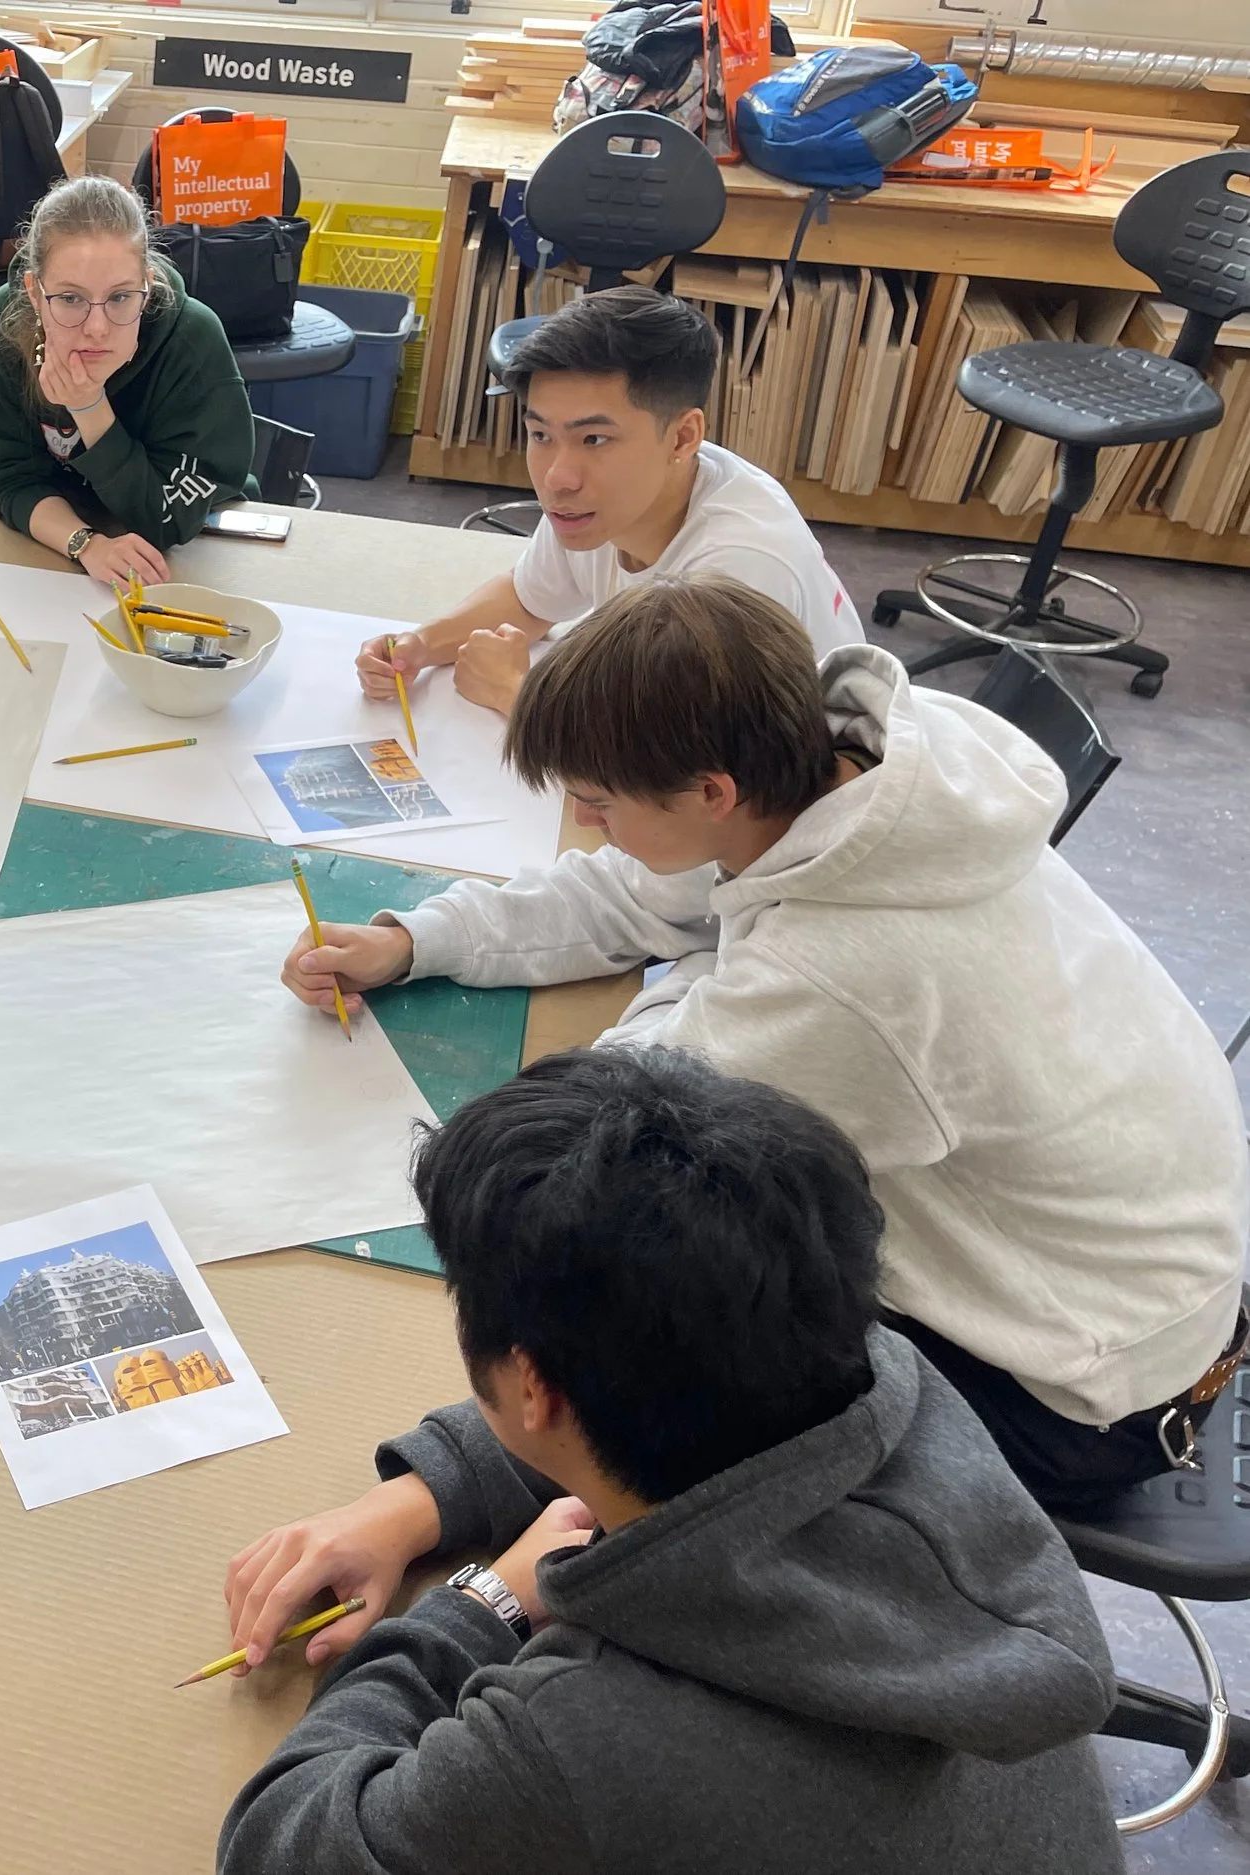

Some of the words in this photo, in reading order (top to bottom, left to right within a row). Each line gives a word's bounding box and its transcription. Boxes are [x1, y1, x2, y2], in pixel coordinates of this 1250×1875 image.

[203, 53, 271, 81] Wood
[278, 58, 355, 87] Waste
[989, 141, 1013, 164] My
[173, 155, 202, 177] My
[173, 172, 271, 195] intellectual
[174, 198, 253, 221] property.
